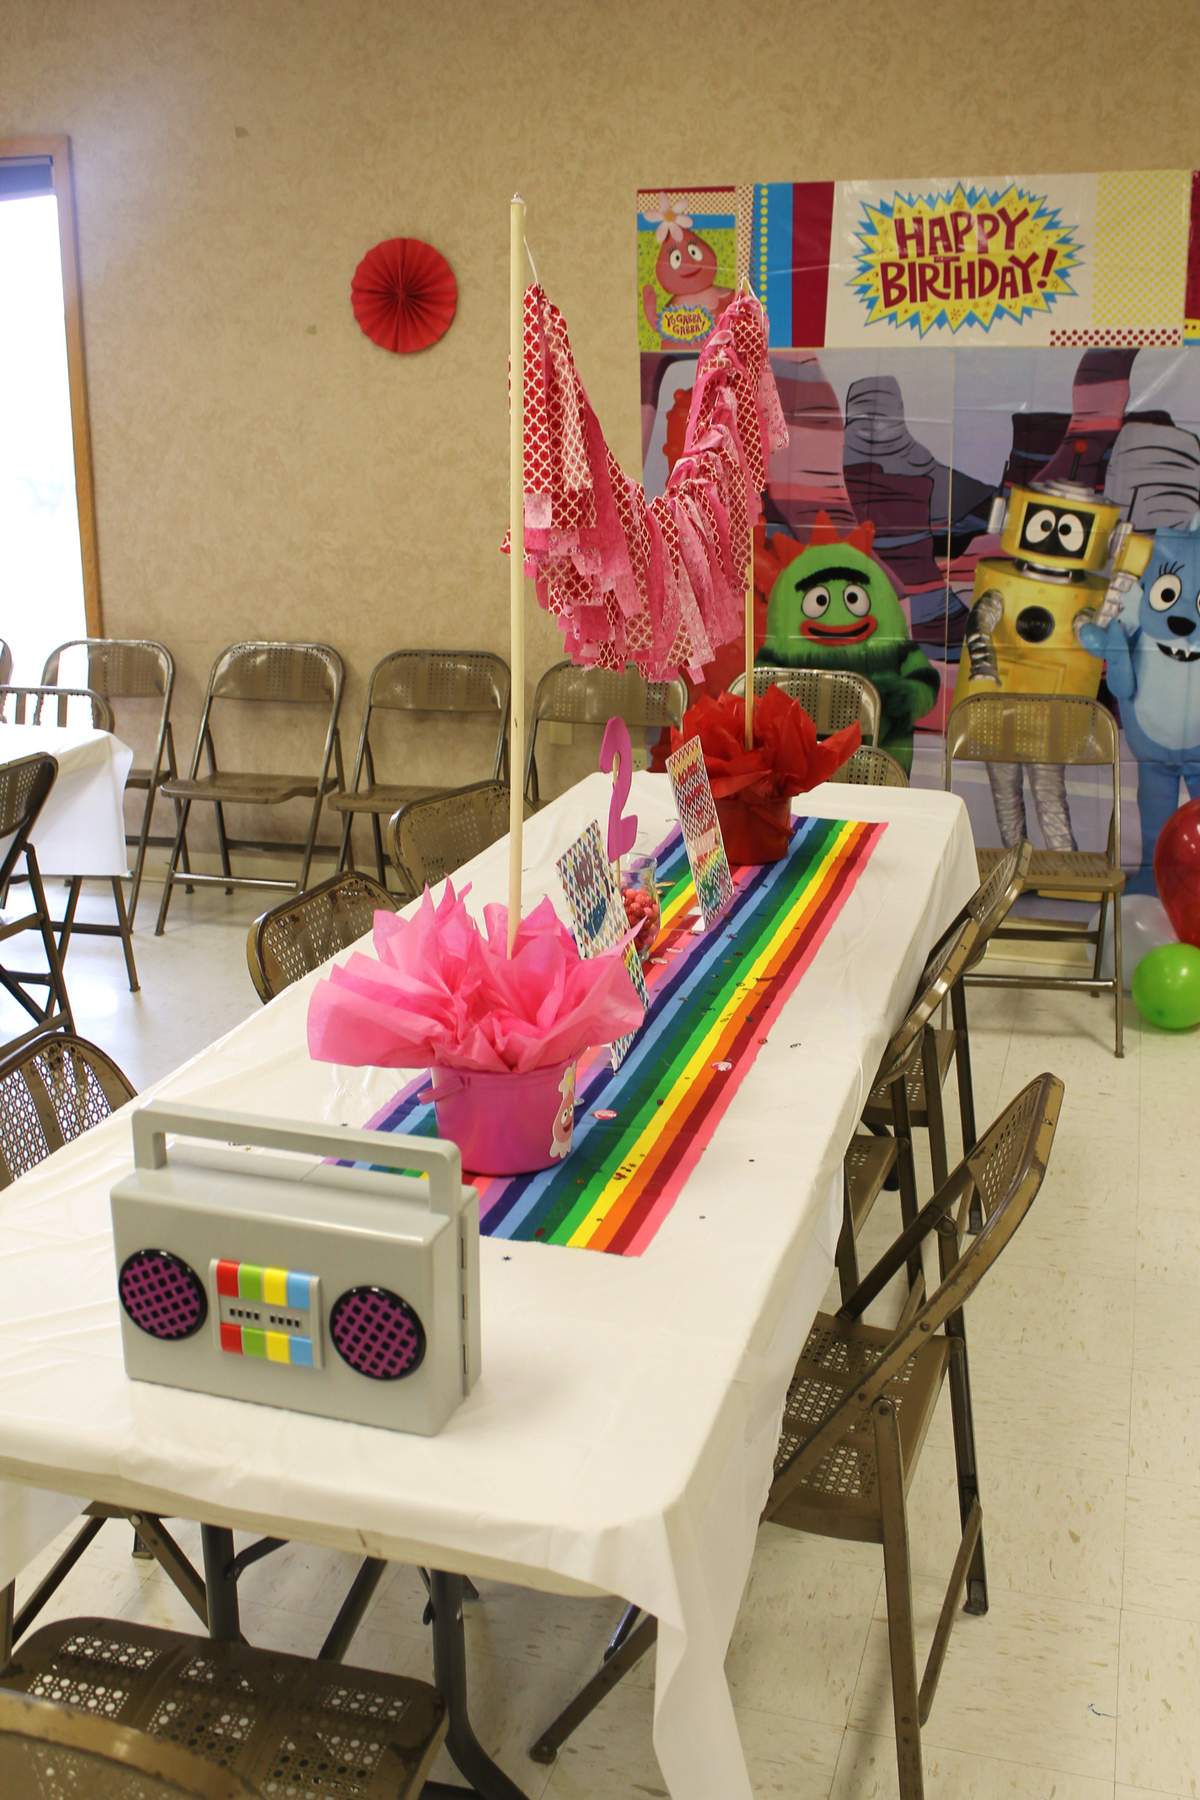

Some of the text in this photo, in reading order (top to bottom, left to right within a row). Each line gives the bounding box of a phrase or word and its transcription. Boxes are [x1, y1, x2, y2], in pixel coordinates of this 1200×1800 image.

[894, 207, 1030, 260] HAPPY
[880, 248, 1058, 309] BIRTHDAY!
[599, 716, 638, 863] 2
